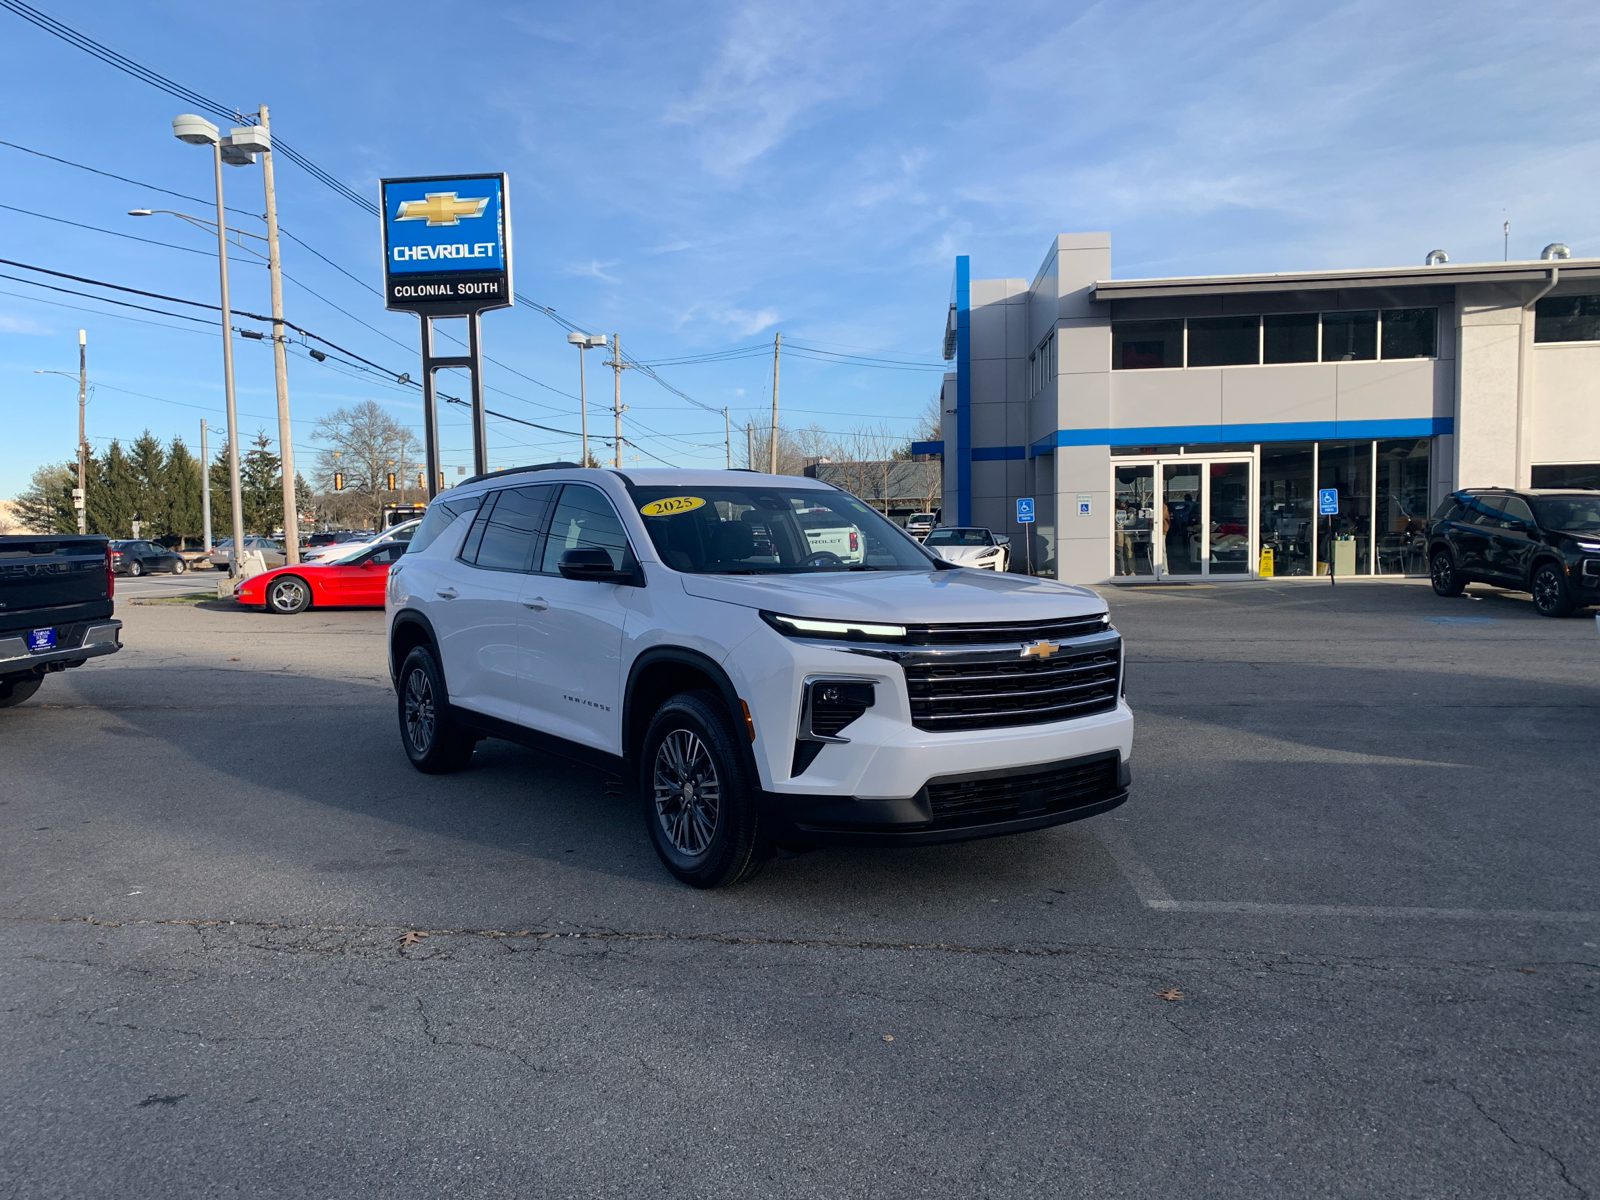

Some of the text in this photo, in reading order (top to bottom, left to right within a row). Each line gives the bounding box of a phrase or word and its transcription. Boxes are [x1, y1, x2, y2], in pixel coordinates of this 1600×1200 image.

[393, 242, 496, 261] CHEVROLET
[394, 282, 498, 297] COLONIAL SOUTH
[653, 497, 693, 514] 2025
[562, 694, 611, 712] TRAVERSE
